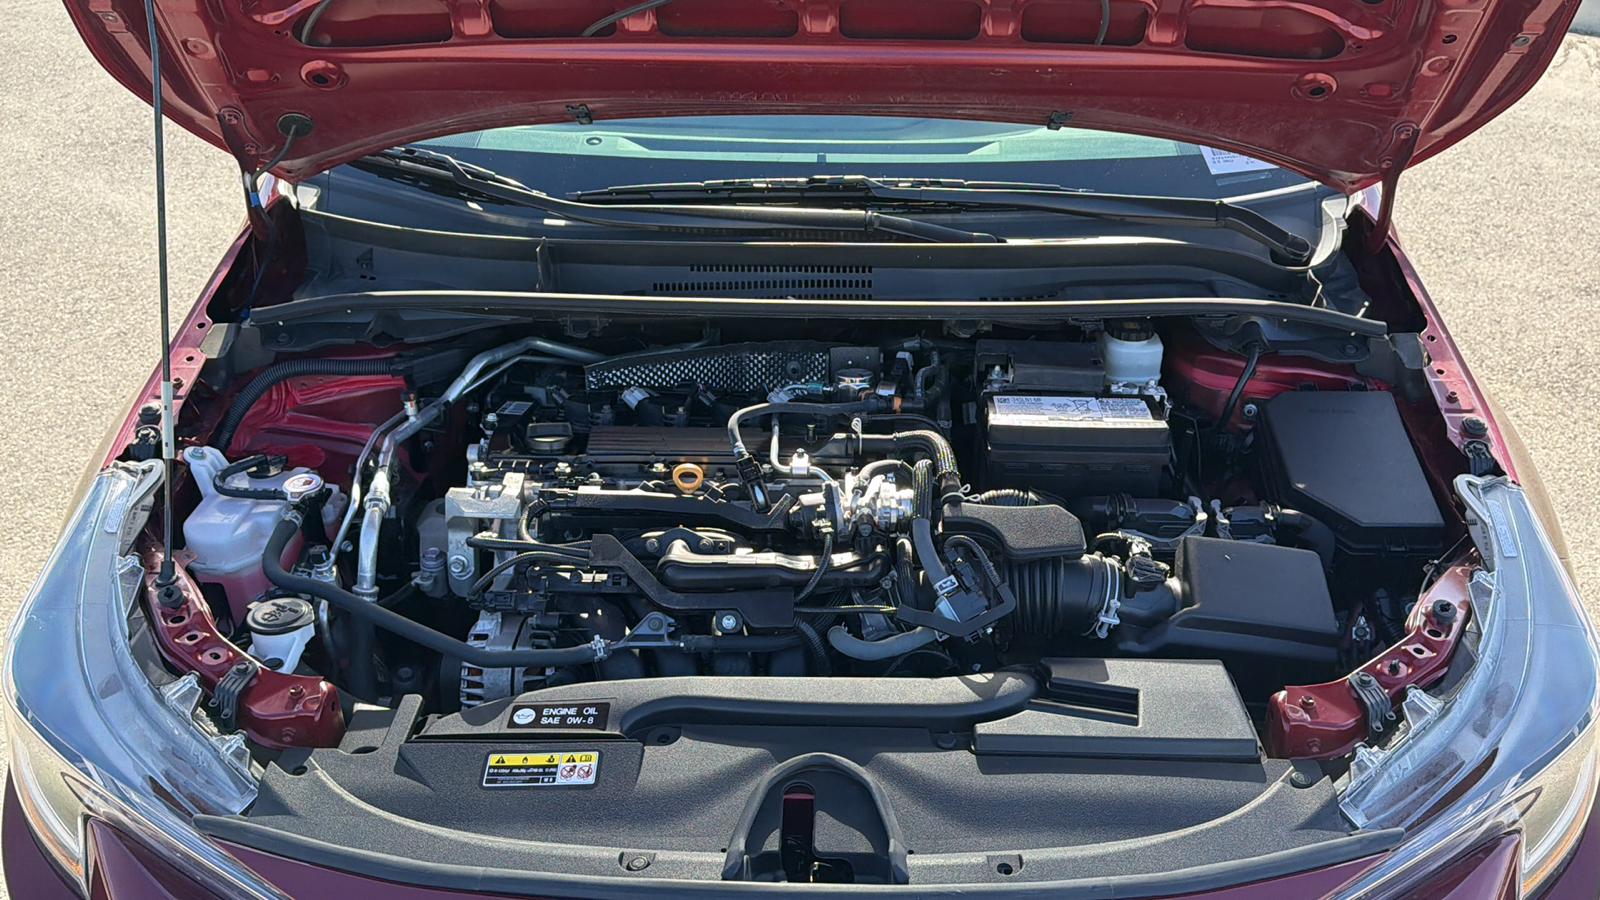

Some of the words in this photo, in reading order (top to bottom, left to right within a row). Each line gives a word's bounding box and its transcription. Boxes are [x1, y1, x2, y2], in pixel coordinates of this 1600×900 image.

[543, 707, 578, 715] ENGINE
[583, 706, 599, 715] OIL
[540, 716, 561, 725] SAE
[566, 716, 594, 725] 0W-8
